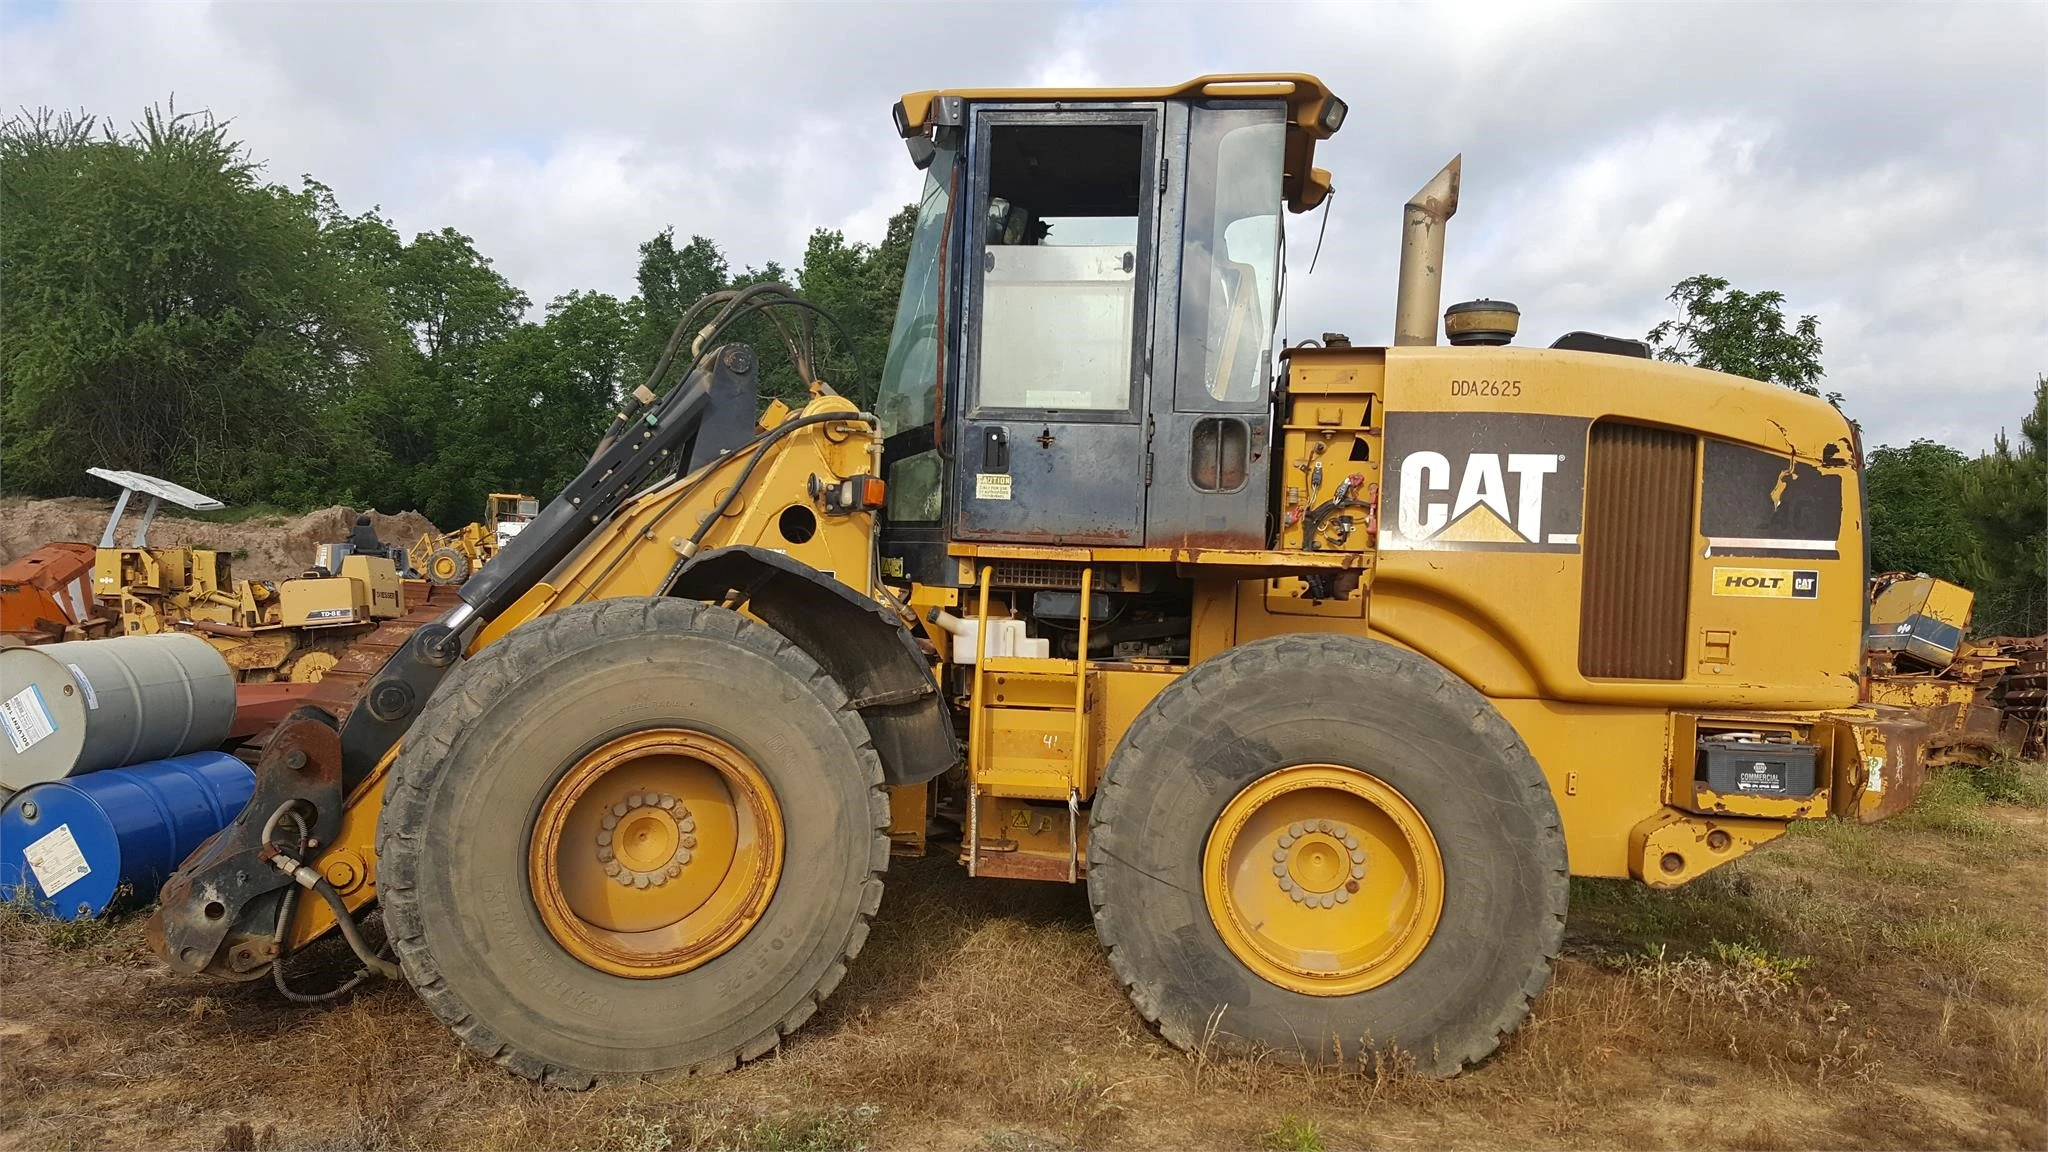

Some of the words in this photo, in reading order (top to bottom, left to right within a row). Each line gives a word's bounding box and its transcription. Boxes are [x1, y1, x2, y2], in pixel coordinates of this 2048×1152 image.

[1451, 380, 1521, 397] DDA2625
[1397, 450, 1559, 544] CAT
[1725, 576, 1784, 589] HOLT
[1795, 578, 1815, 590] CAT
[11, 716, 30, 747] SOLVENT
[1740, 773, 1780, 782] COMMERCIAL
